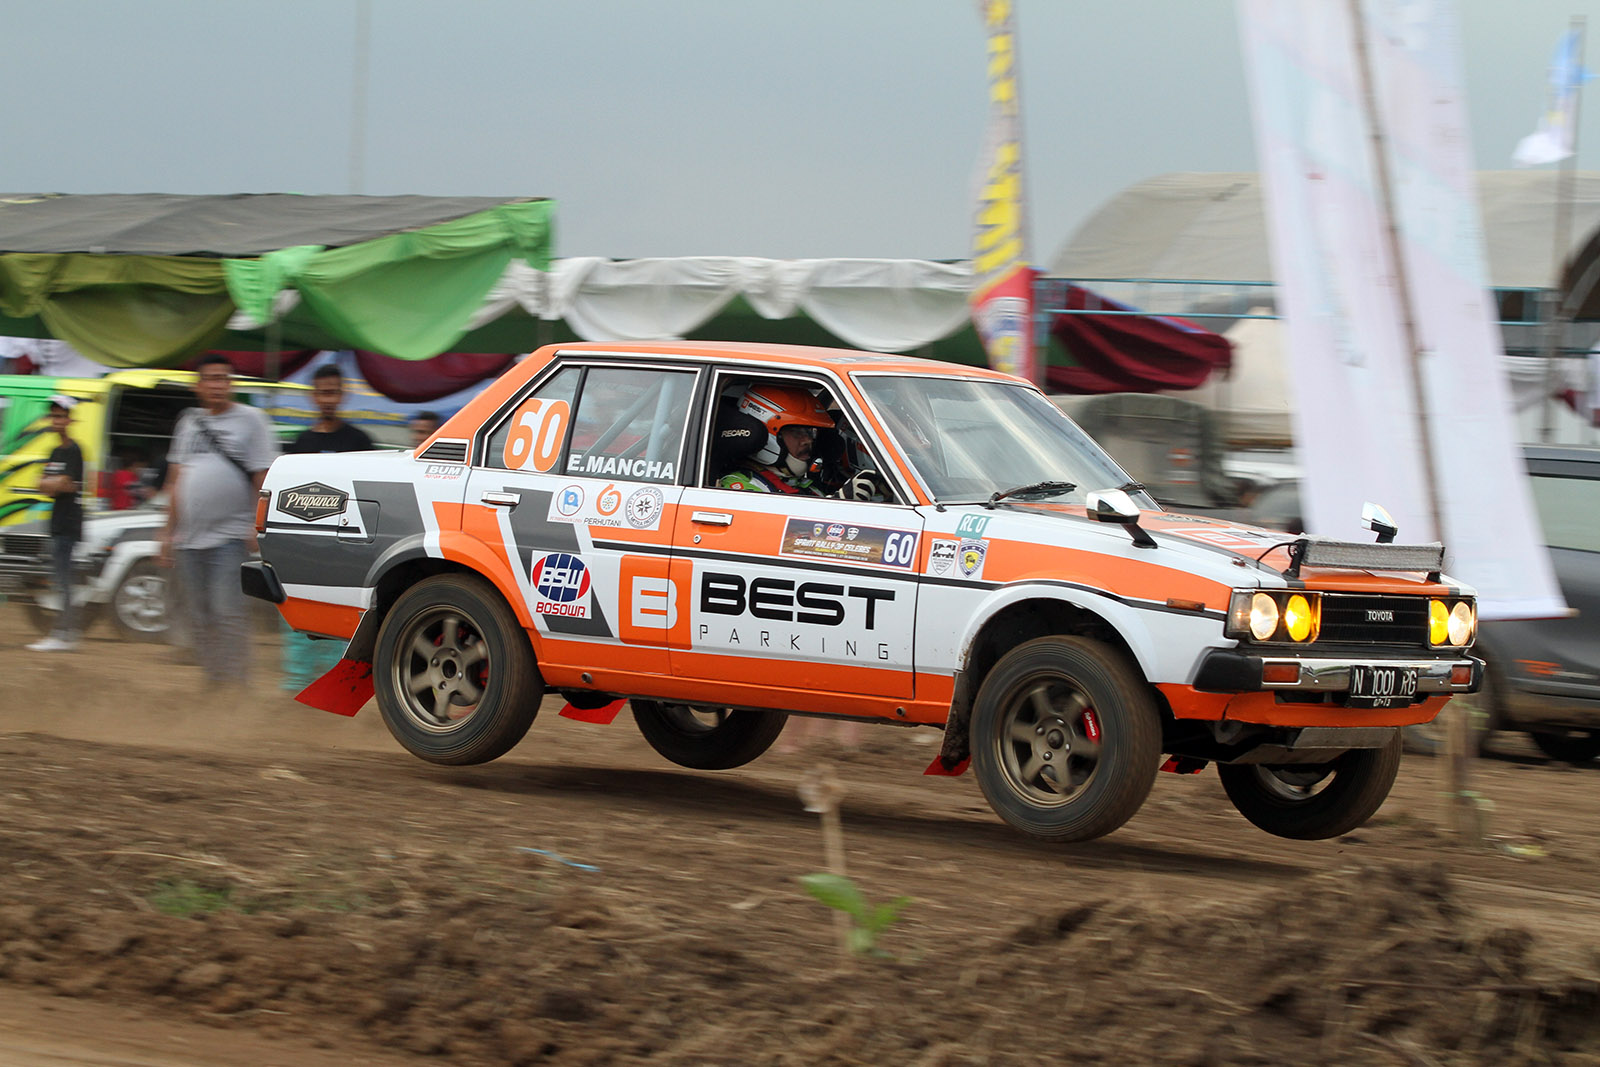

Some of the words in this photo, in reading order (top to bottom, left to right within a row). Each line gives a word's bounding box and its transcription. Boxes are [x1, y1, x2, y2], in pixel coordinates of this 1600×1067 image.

[503, 397, 571, 473] 60
[721, 429, 750, 437] RECARO
[428, 465, 461, 475] BUM
[567, 454, 674, 479] E.MANCHA
[285, 492, 340, 511] Prapanca
[584, 517, 621, 526] PERHUTANI
[794, 539, 816, 547] SPRINT
[844, 545, 871, 553] CELEBES
[884, 532, 913, 564] 60
[536, 601, 586, 617] BOSOWA
[700, 572, 895, 630] BEST
[1367, 610, 1394, 621] TOYOTA
[700, 624, 889, 660] PARKING
[1353, 668, 1364, 694] N
[1372, 670, 1395, 695] 1001
[1400, 670, 1417, 695] RG
